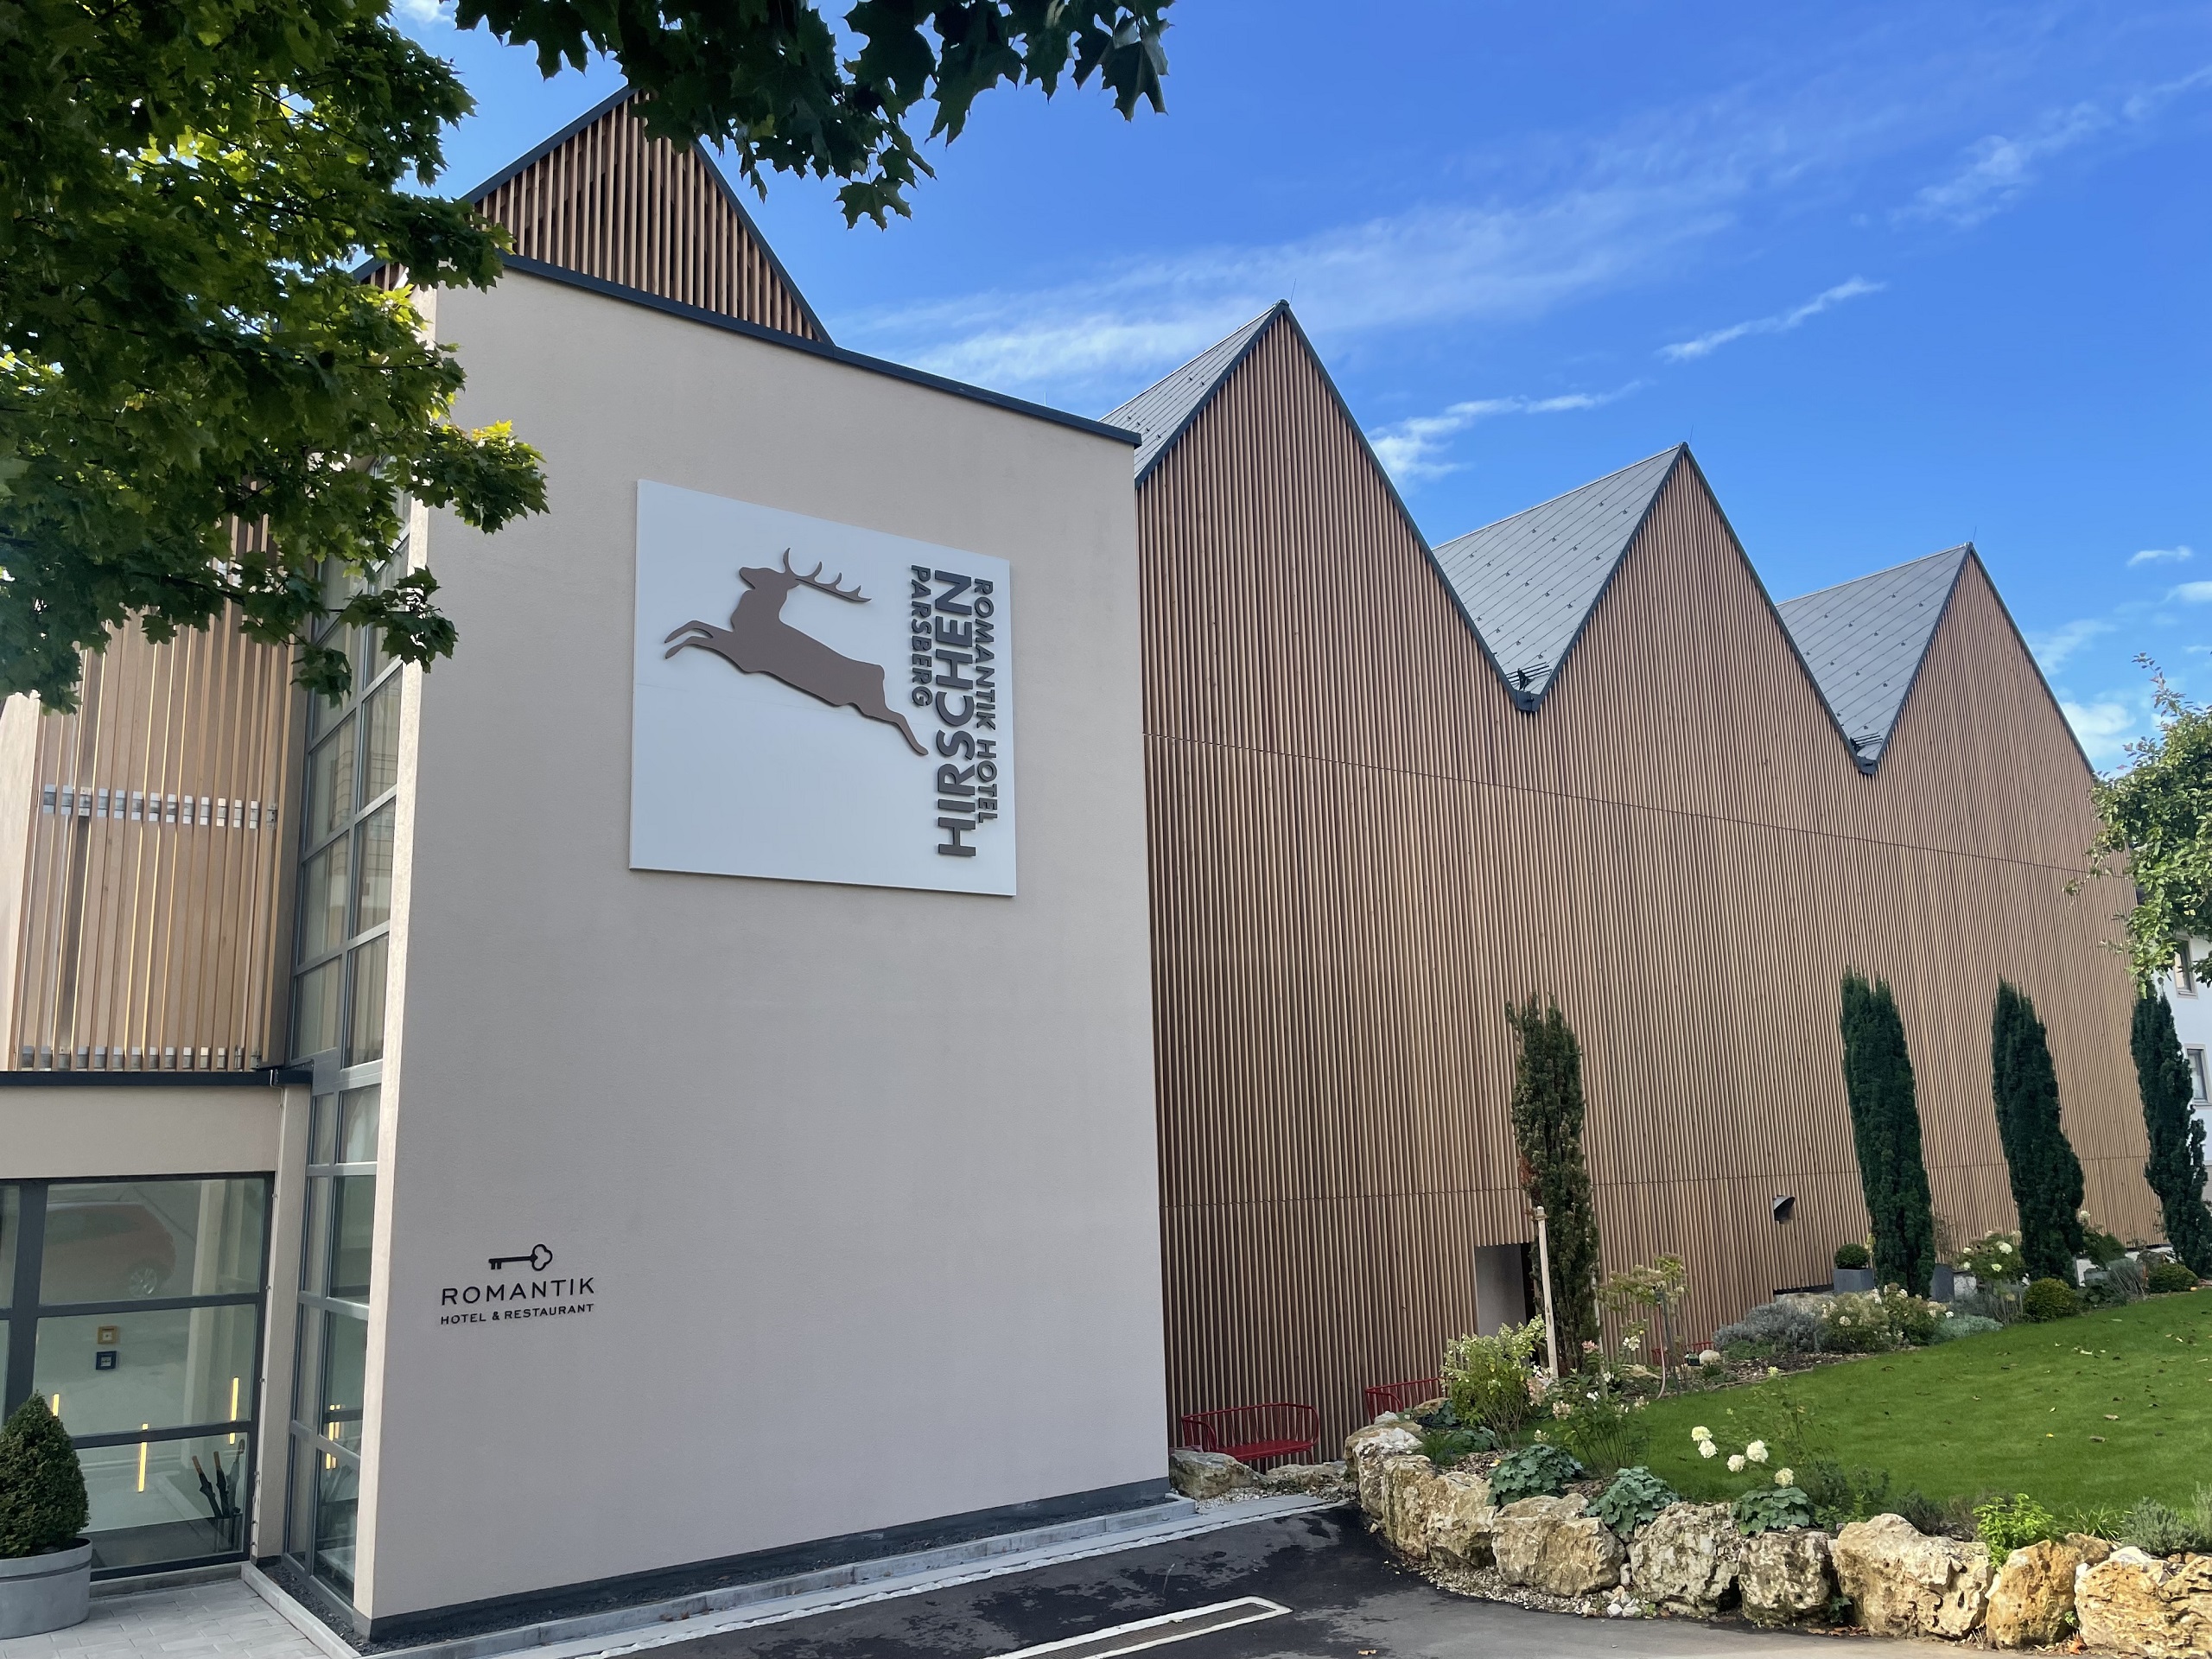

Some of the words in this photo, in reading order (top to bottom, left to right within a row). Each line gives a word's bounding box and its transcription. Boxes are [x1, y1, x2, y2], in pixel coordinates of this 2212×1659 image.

[911, 564, 932, 706] PARSBERG
[974, 578, 996, 730] ROMANTIK
[935, 569, 976, 857] HIRSCHEN
[977, 739, 997, 823] HOTEL
[441, 1277, 594, 1306] ROMANTIK
[441, 1313, 486, 1325] HOTEL
[492, 1311, 500, 1320] &
[504, 1303, 594, 1319] RESTAURANT
